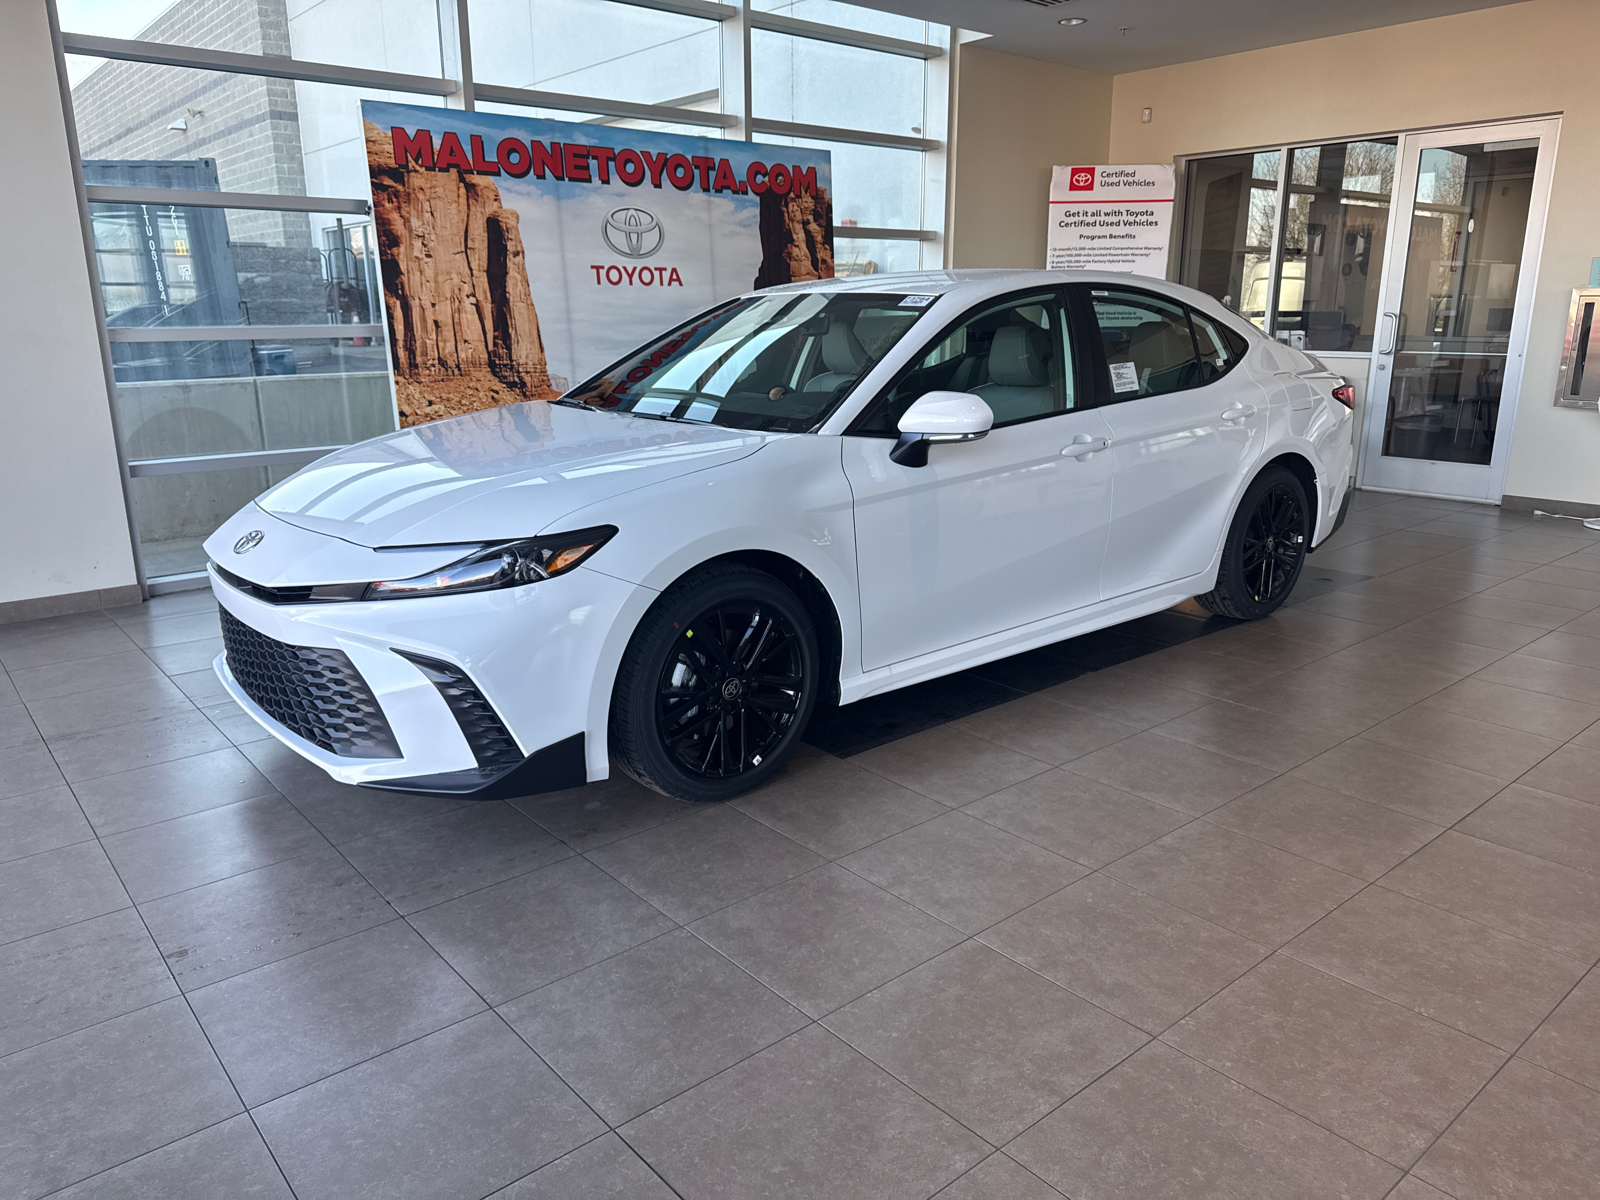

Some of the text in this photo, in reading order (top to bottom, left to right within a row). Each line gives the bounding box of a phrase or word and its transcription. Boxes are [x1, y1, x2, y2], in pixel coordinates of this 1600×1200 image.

[391, 126, 818, 197] MALONETOYOTA.COM
[1100, 170, 1136, 178] Certified
[1122, 179, 1156, 187] Vehicles
[1064, 209, 1154, 218] Get it all with Toyota
[1058, 219, 1159, 228] Certified Used Vehicles
[1079, 233, 1107, 241] Program
[590, 264, 684, 287] TOYOTA
